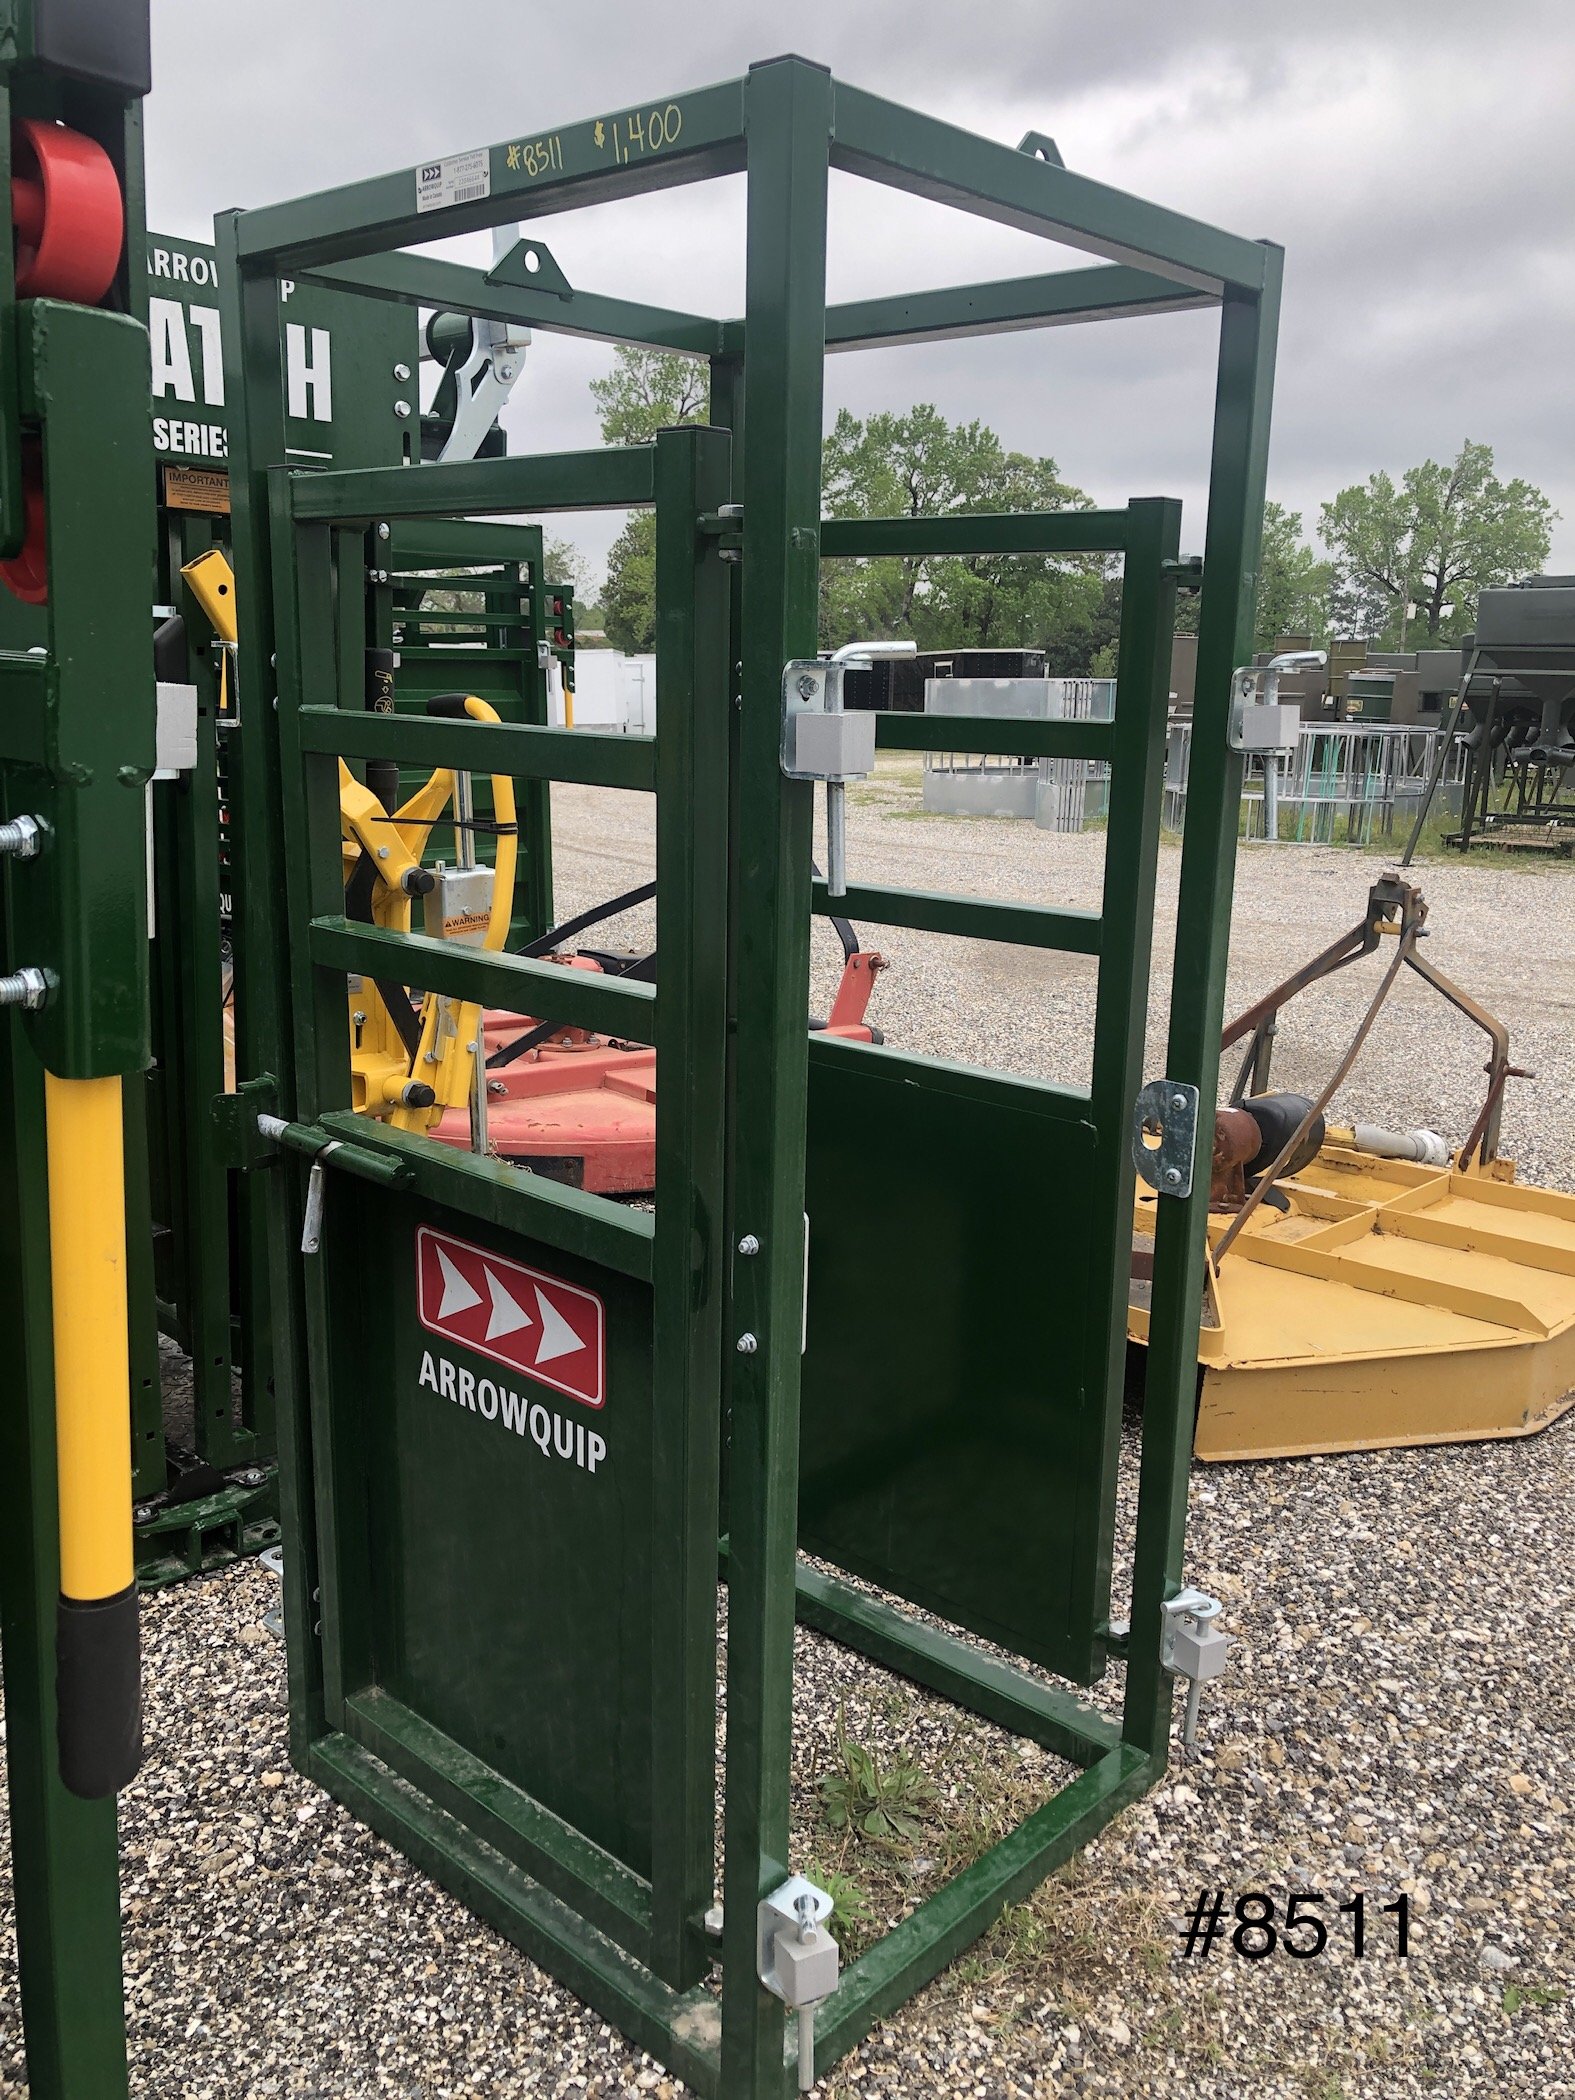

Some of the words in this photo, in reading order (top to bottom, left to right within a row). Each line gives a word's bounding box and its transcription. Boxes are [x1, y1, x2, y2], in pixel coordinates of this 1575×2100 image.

[507, 136, 563, 176] #8511
[169, 472, 230, 488] IMPORTANT
[451, 914, 490, 927] WARNING
[418, 1350, 607, 1474] ARROWQUIP
